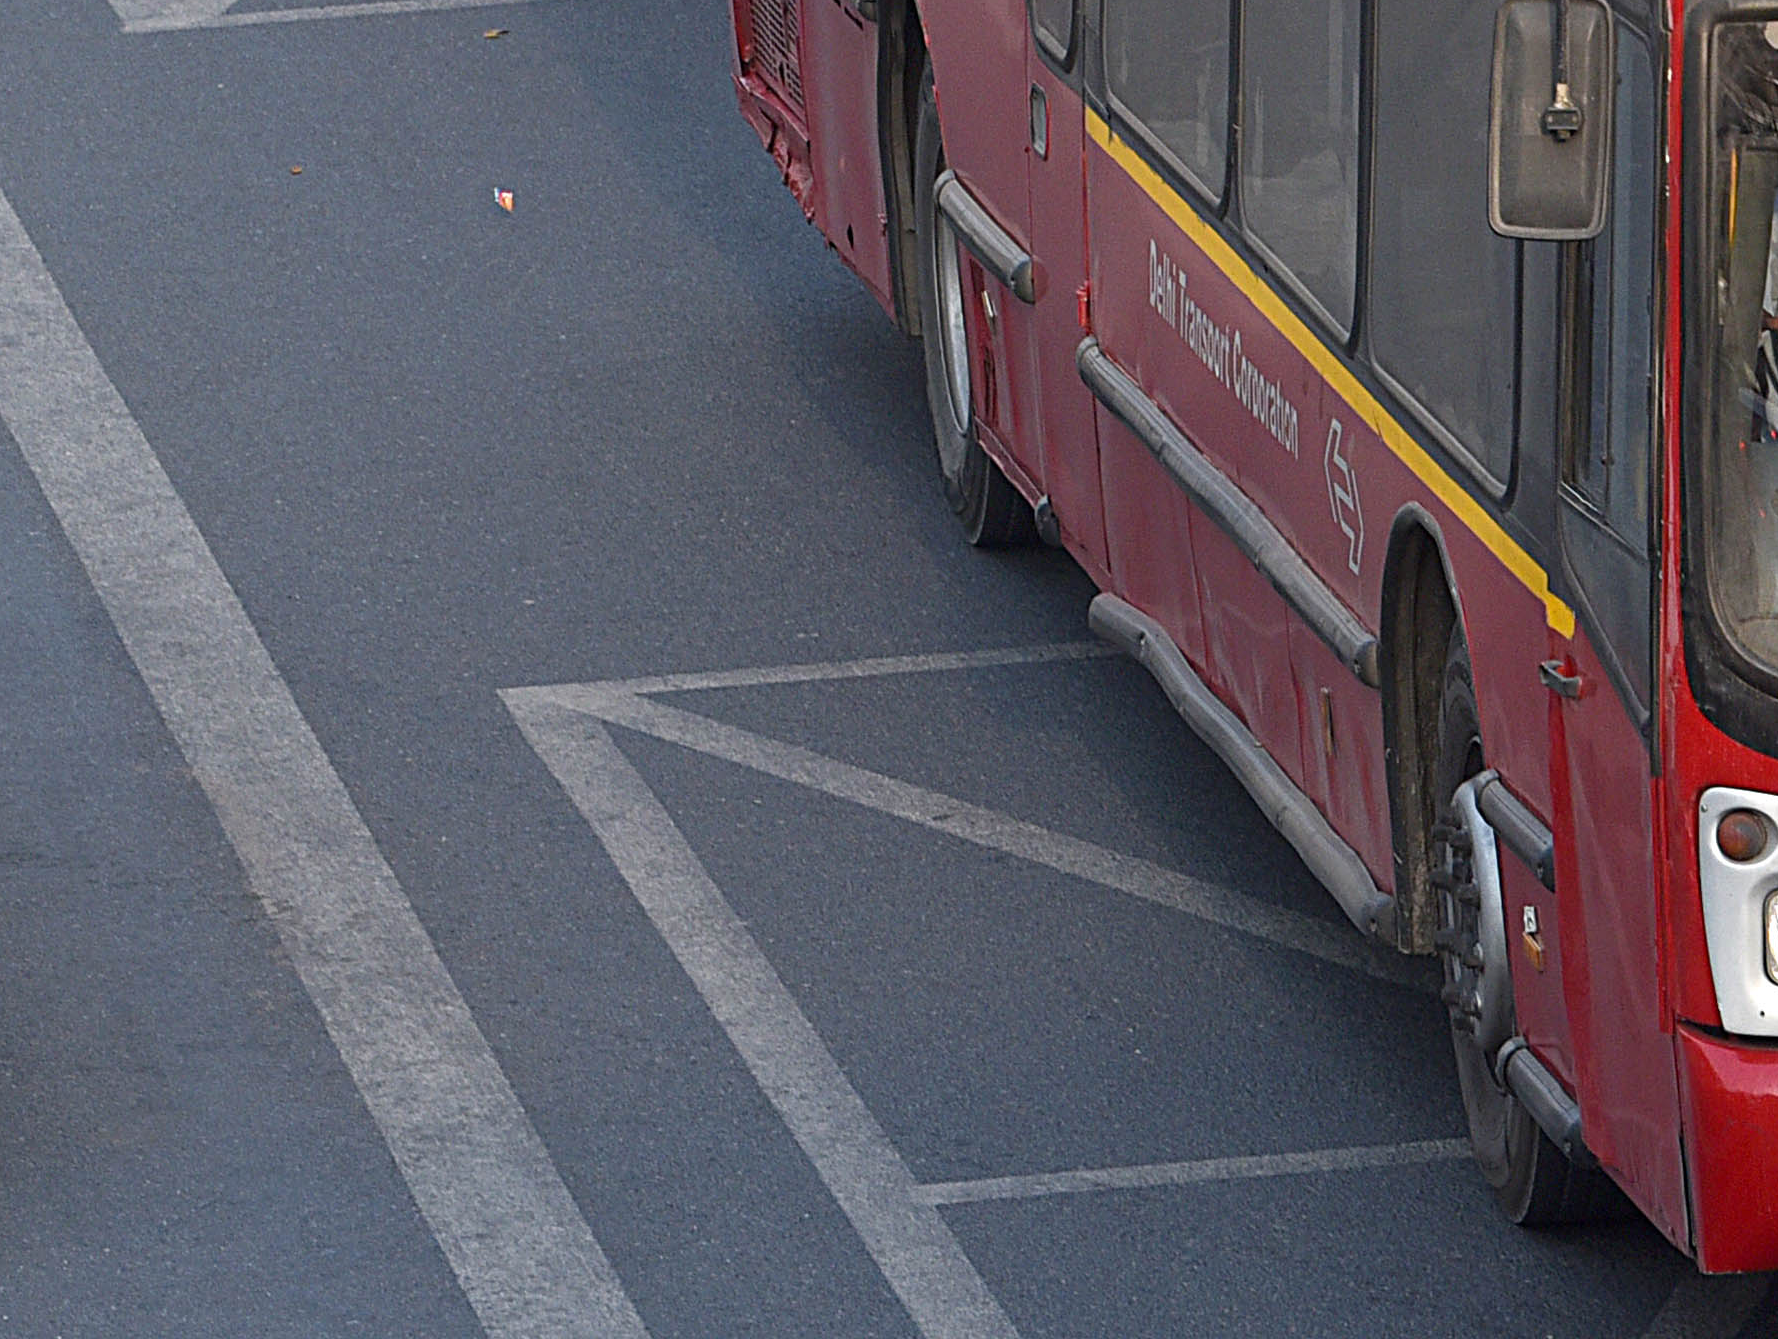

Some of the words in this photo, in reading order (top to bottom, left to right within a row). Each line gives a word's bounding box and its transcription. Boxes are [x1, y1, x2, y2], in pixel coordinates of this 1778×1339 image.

[1149, 238, 1177, 329] Delhi
[1178, 270, 1231, 390] Transport
[1233, 328, 1299, 460] Corporation
